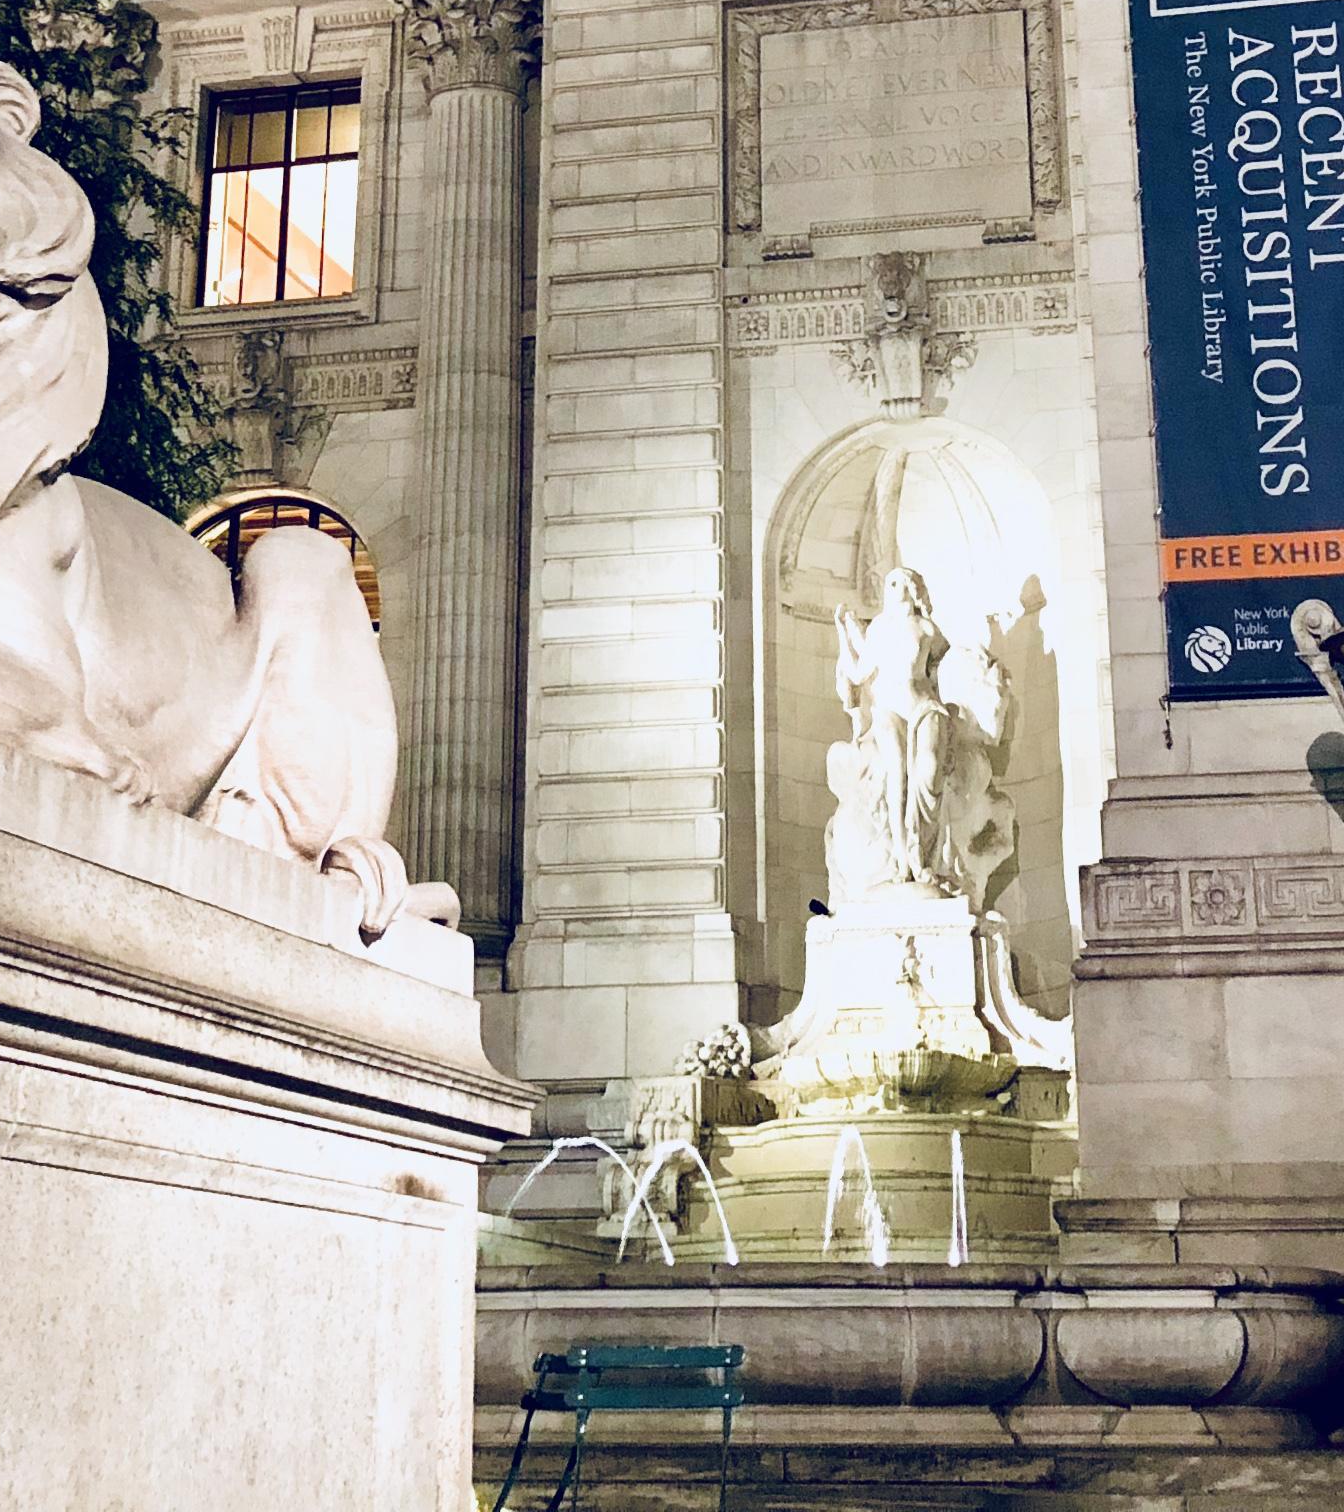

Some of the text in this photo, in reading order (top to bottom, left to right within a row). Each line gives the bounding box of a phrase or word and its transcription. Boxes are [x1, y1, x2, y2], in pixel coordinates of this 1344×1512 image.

[834, 34, 947, 60] BEAUTY
[764, 79, 822, 105] OLD
[882, 68, 949, 96] EVER
[956, 61, 1021, 90] NEW
[919, 102, 1007, 128] VOICE
[764, 154, 822, 179] AND
[941, 136, 1026, 166] WORD
[1184, 32, 1228, 385] The New York Public Library
[1227, 28, 1310, 496] ACQUISITIONS
[1174, 542, 1243, 569] FREE
[1234, 606, 1290, 621] New York
[1235, 623, 1270, 635] Public
[1236, 637, 1284, 652] Library
